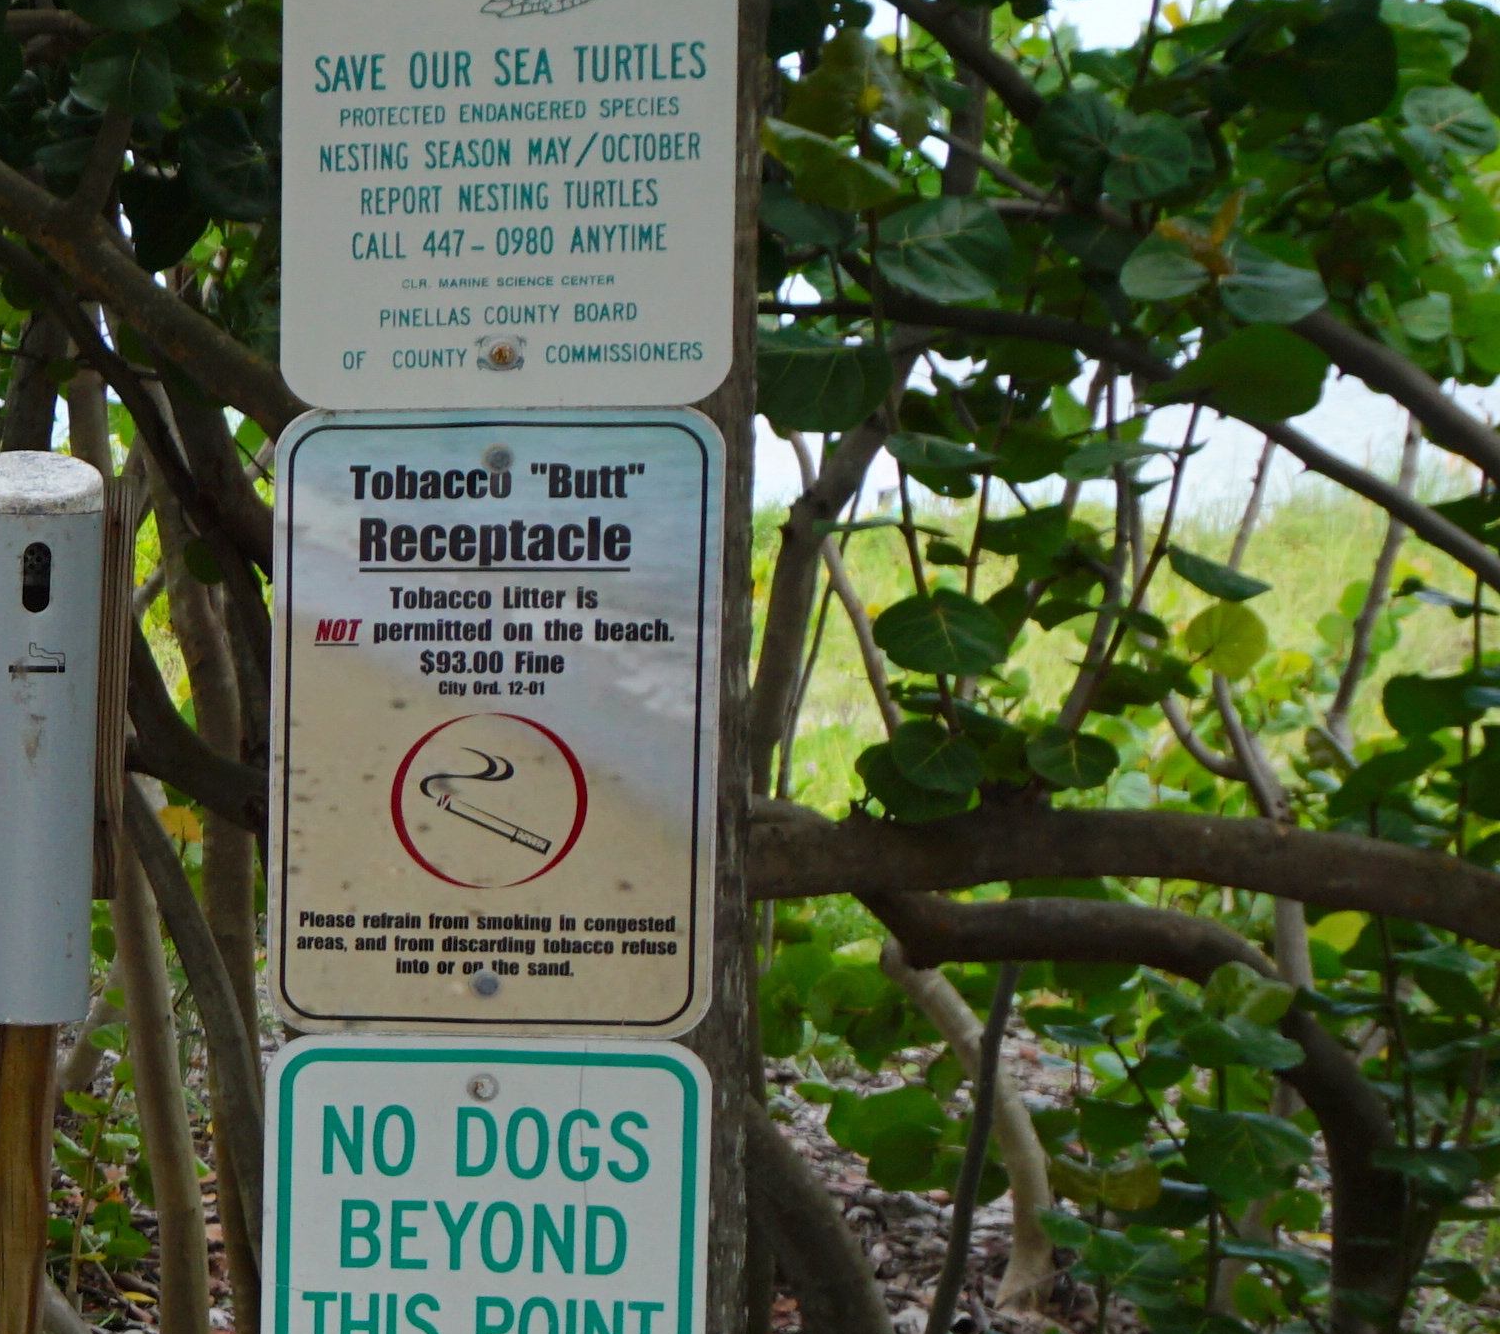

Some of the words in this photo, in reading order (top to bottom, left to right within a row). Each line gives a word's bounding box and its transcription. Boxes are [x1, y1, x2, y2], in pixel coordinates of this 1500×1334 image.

[314, 53, 387, 93] SAVE
[409, 50, 472, 90] OUR
[494, 47, 553, 86] SEA
[572, 41, 707, 82] TURTLES
[339, 104, 446, 127] PROTECTED
[458, 100, 587, 123] ENDANGERED
[599, 96, 681, 118] SPECIES
[319, 142, 409, 173] NESTING
[424, 139, 511, 169] SEASON
[359, 185, 442, 216] REPORT
[458, 182, 550, 213] NESTING
[564, 179, 659, 209] TURTLES
[350, 231, 406, 262] CALL
[570, 223, 668, 253] ANYTIME
[401, 279, 431, 289] CLR.
[438, 277, 489, 288] MARINE
[497, 276, 554, 287] SCIENCE
[560, 275, 616, 286] CENTER
[379, 307, 471, 328] PINELLAS
[484, 304, 561, 325] COUNTY
[574, 302, 638, 323] BOARD
[342, 350, 367, 370] OF
[392, 348, 468, 369] COUNTY
[545, 341, 704, 364] COMMISSIONERS
[349, 465, 512, 500] Tobacco
[530, 463, 646, 499] "Butt"
[359, 516, 632, 567] Receptacle
[389, 586, 493, 610] Tobacco
[503, 587, 566, 610] Litter
[576, 587, 599, 609] is
[315, 618, 363, 643] NOT
[373, 620, 493, 644] permitted
[503, 622, 533, 642] on
[544, 620, 583, 642] the
[594, 619, 675, 642] beach.
[419, 650, 504, 677] $93.00
[515, 651, 565, 675] Fine
[439, 680, 467, 696] City
[473, 680, 501, 695] Ord.
[508, 681, 545, 695] 12-01
[299, 911, 356, 929] Please
[363, 912, 421, 930] refrain
[429, 913, 469, 930] from
[477, 914, 552, 933] smoking
[559, 915, 576, 931] in
[584, 916, 676, 934] congested
[296, 936, 348, 952] areas,
[355, 935, 387, 952] and
[394, 936, 434, 952] from
[442, 936, 536, 955] discarding
[543, 938, 614, 954] tobacco
[622, 939, 677, 955] refuse
[396, 958, 430, 974] into
[437, 960, 455, 975] or
[492, 959, 520, 976] the
[527, 960, 574, 977] sand.
[321, 1104, 416, 1177] NO
[455, 1106, 651, 1183] DOGS
[339, 1199, 628, 1276] BEYOND
